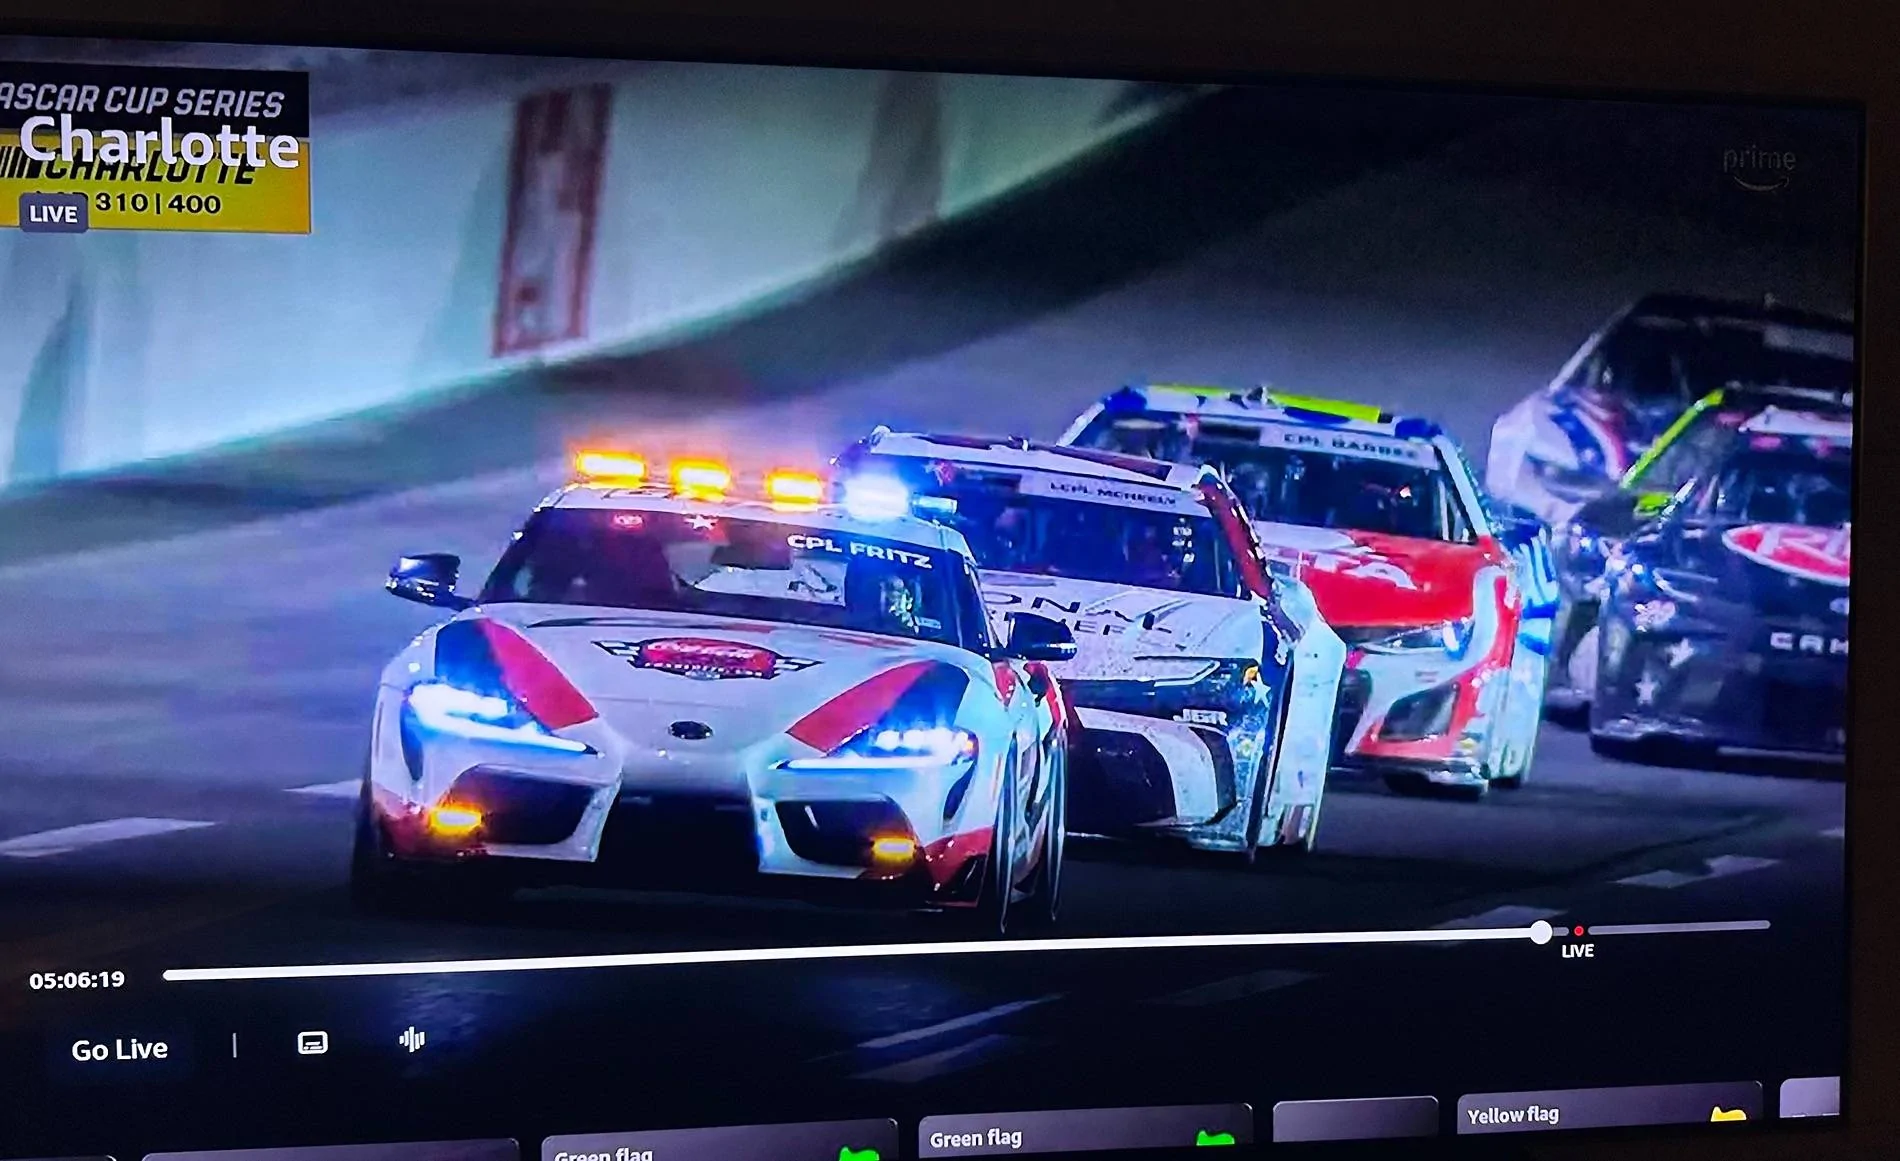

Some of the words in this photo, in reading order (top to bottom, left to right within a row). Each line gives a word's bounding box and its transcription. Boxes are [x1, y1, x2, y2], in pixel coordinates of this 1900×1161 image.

[104, 86, 168, 115] CUP
[174, 88, 285, 119] SERIES
[20, 113, 299, 169] Charlotte
[1723, 144, 1796, 173] prime
[30, 205, 78, 223] LIVE
[787, 534, 842, 553] CPL
[850, 541, 932, 569] FRITZ
[1562, 943, 1595, 959] LIVE
[29, 970, 125, 990] 05:06:19
[72, 1040, 109, 1061] Go
[116, 1039, 168, 1060] Live
[1467, 1107, 1525, 1125] Yellow
[1526, 1105, 1559, 1125] flag
[930, 1132, 983, 1148] Green
[987, 1127, 1022, 1149] flag
